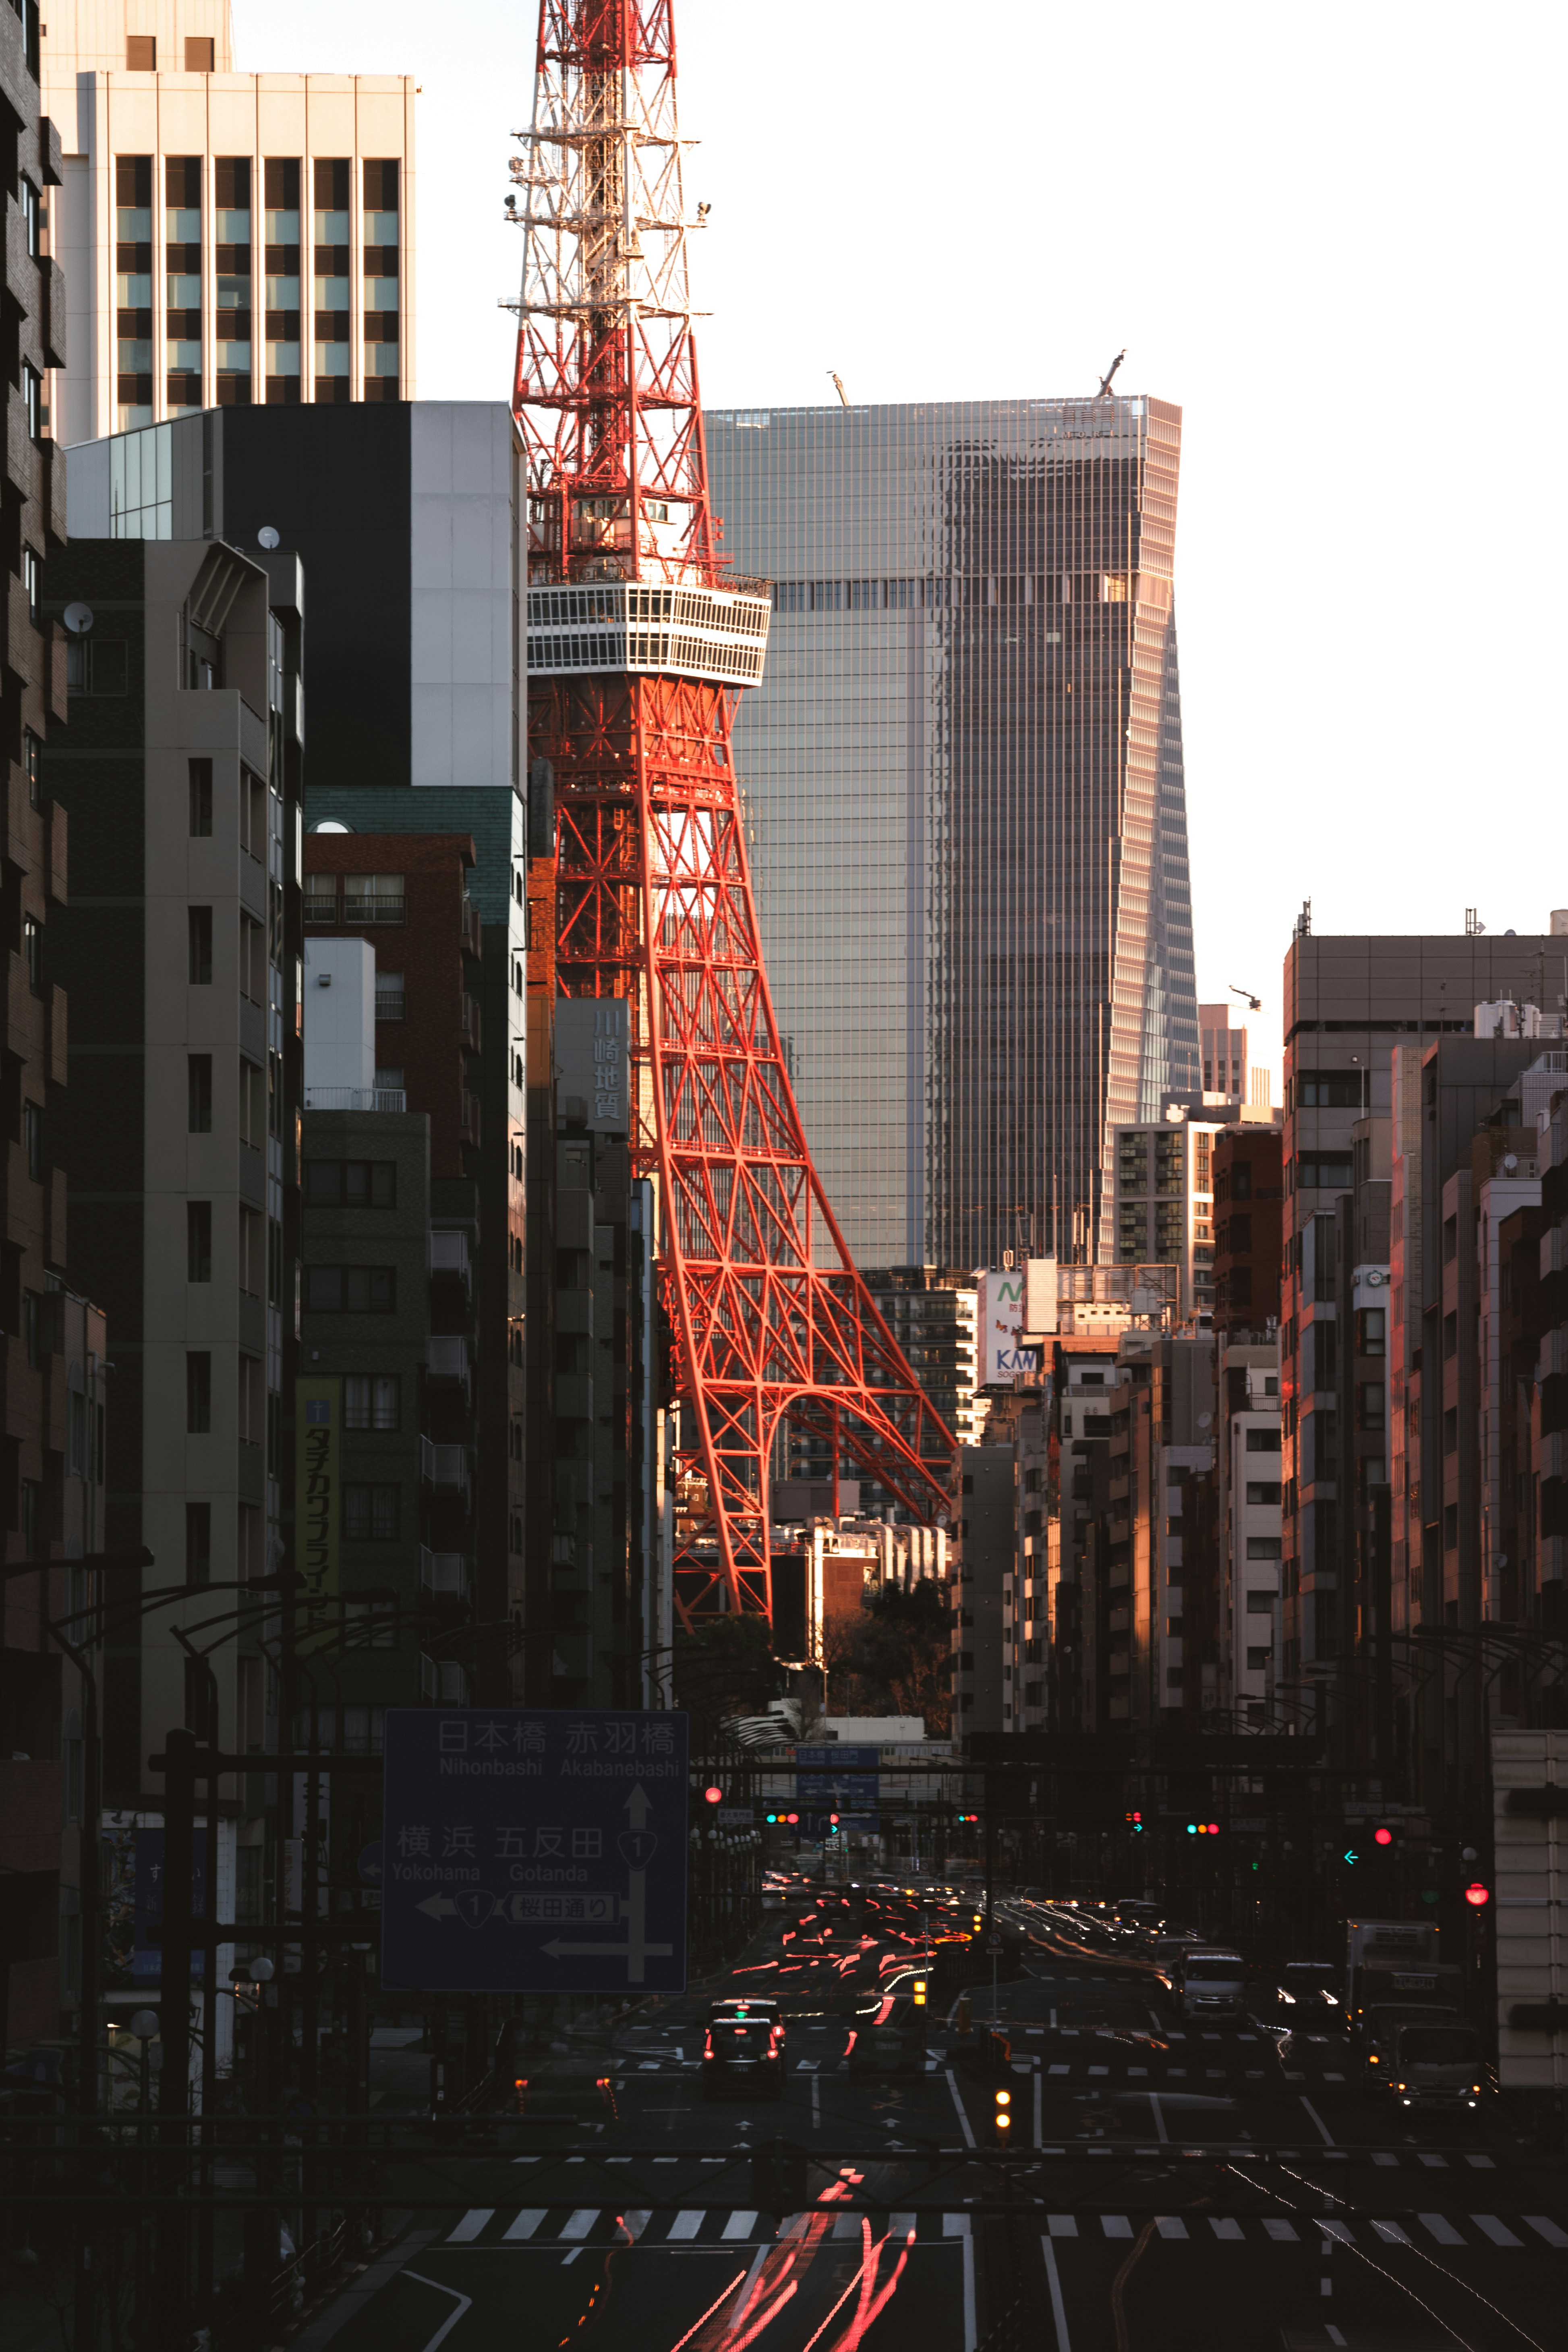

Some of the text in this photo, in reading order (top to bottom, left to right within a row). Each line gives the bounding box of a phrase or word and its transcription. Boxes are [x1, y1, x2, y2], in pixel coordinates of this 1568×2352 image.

[1063, 430, 1113, 438] MORI
[593, 1010, 620, 1120] 川崎地質
[439, 1720, 675, 1755] 日本橋 赤羽橋
[440, 1758, 679, 1777] Nihonbashi Akabanebashi
[397, 1825, 603, 1859] 横浜 五反田
[632, 1836, 642, 1857] 1
[392, 1863, 588, 1882] Yokohama Gotanda
[470, 1896, 478, 1917] 1
[519, 1898, 607, 1918] 桜田通り
